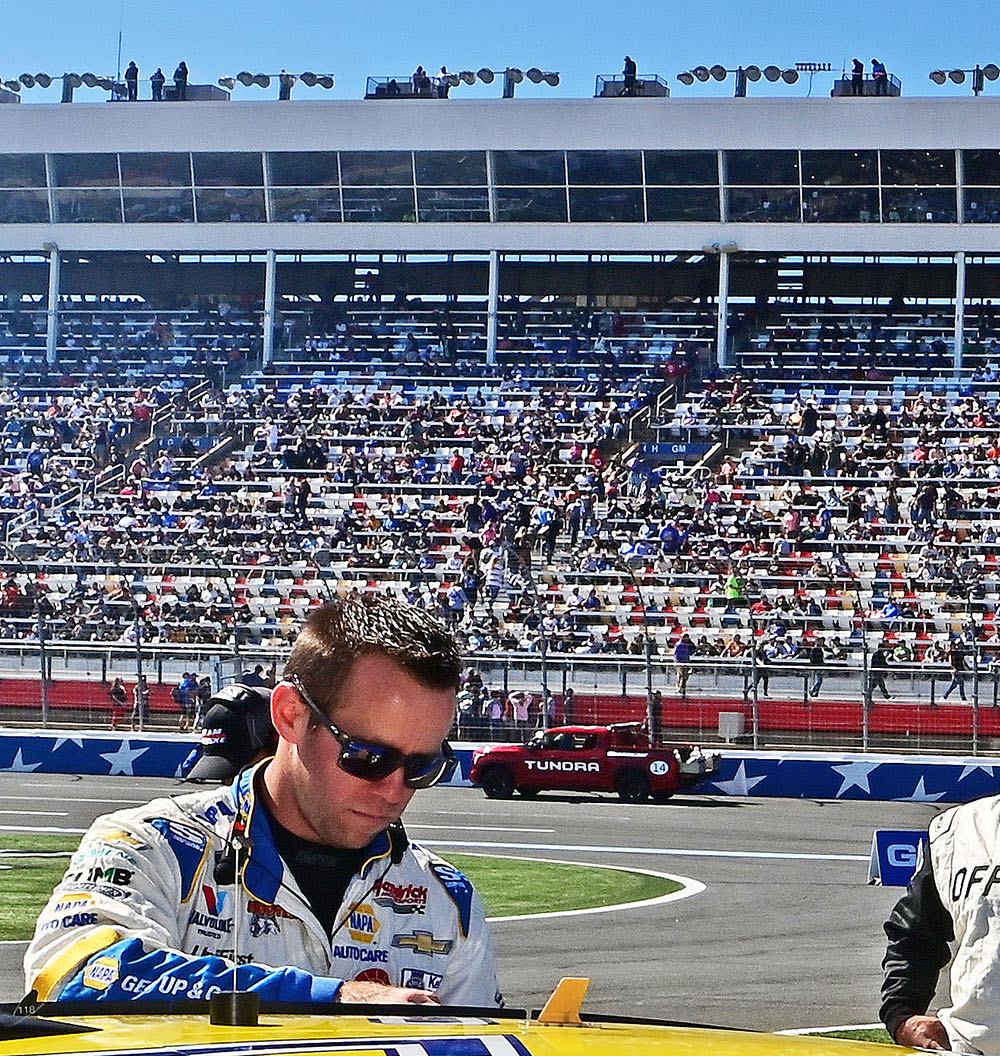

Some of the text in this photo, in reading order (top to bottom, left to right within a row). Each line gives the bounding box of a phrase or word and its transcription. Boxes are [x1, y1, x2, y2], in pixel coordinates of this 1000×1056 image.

[651, 444, 687, 453] H GM
[524, 760, 600, 772] TUNDRA
[652, 762, 666, 773] 14
[886, 843, 918, 868] G
[61, 912, 99, 930] CARE
[349, 912, 375, 934] NAPA
[158, 975, 188, 996] UP
[18, 1004, 36, 1015] 118
